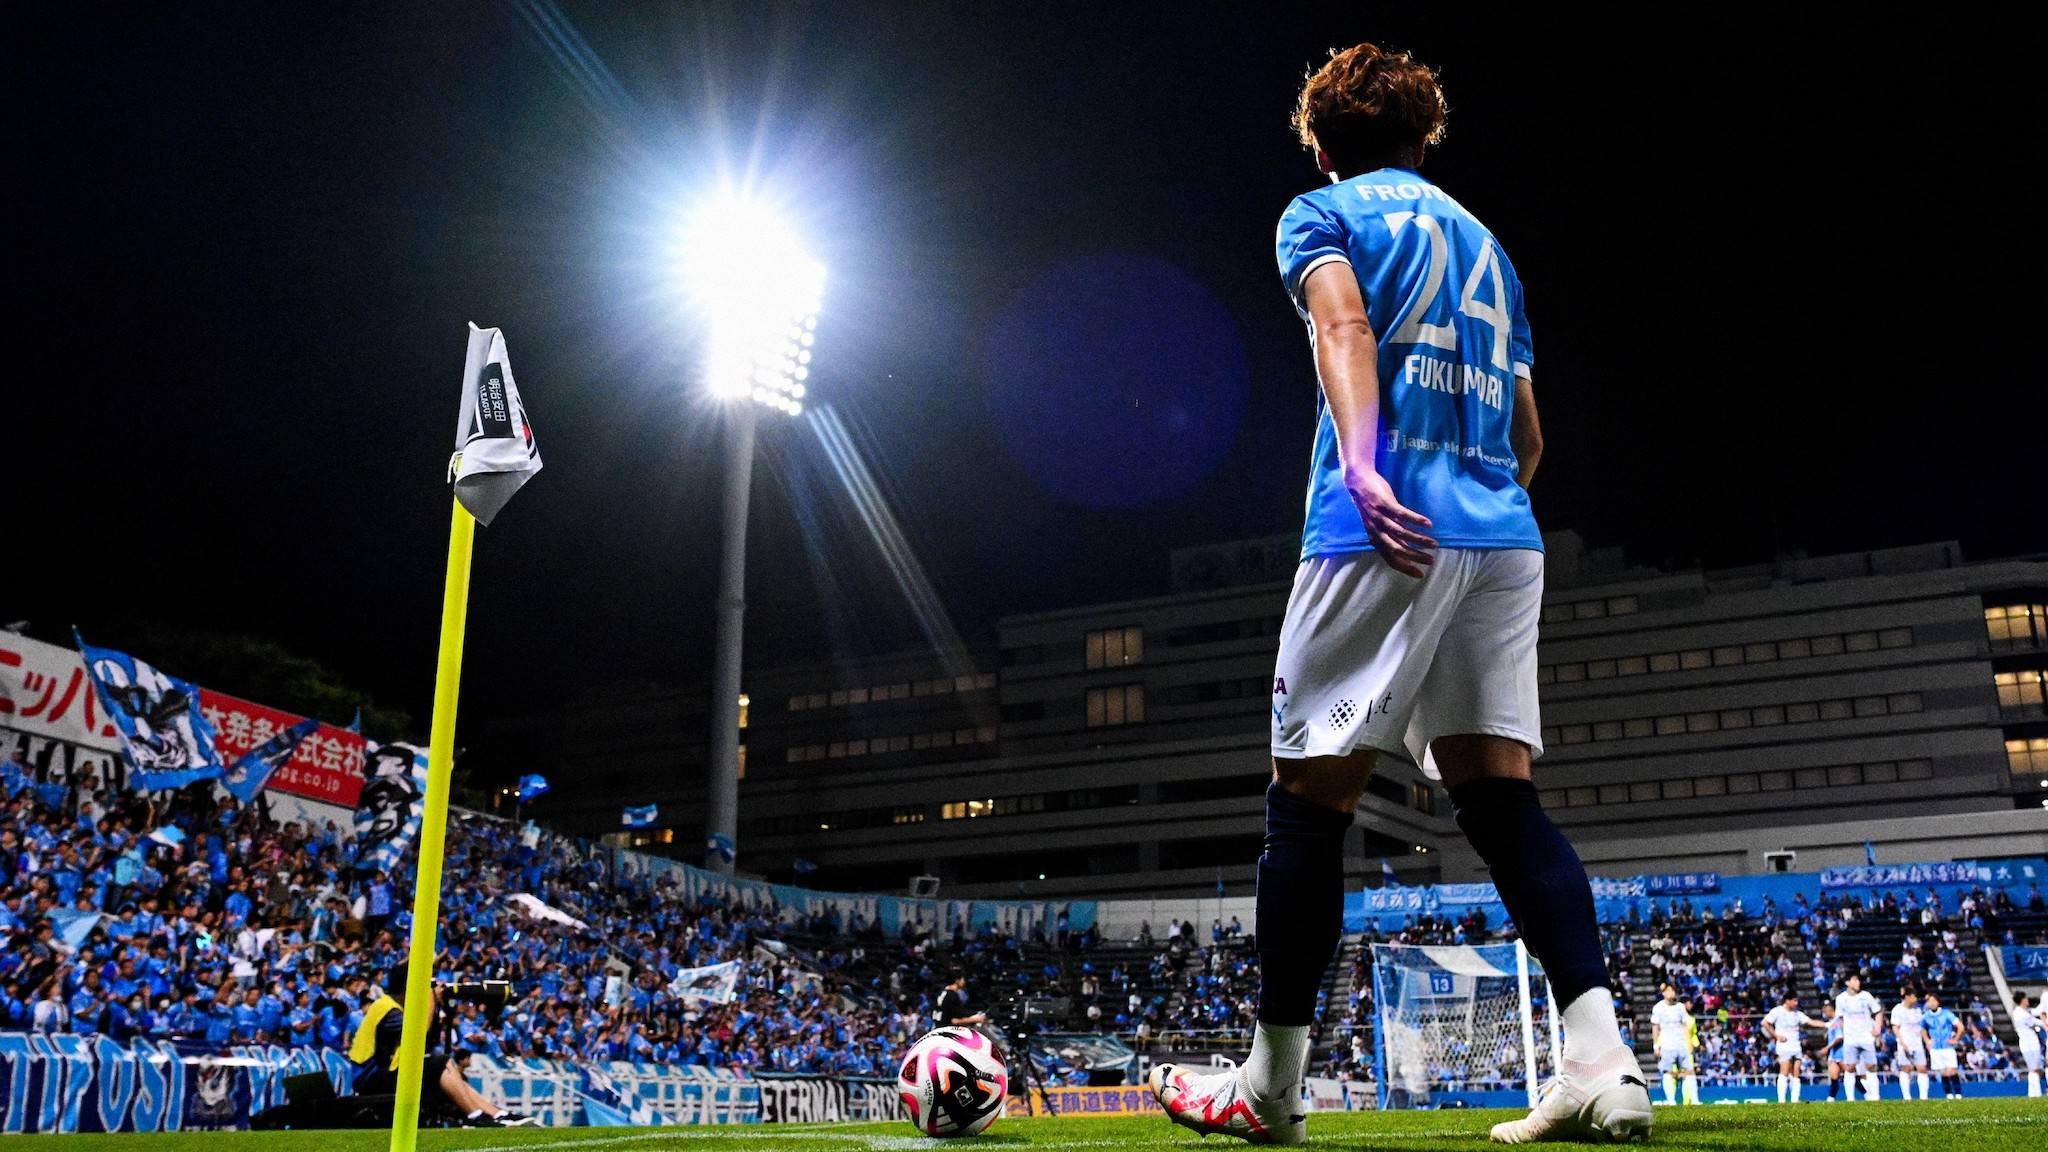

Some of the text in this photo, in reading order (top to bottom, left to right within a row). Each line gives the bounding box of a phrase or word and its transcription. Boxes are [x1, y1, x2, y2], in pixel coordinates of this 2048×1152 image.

[1382, 211, 1510, 372] 24
[488, 378, 506, 421] 明治安田
[1405, 354, 1503, 411] FUKUMORI
[757, 1079, 850, 1123] ETERNAL
[863, 1083, 904, 1121] BOY
